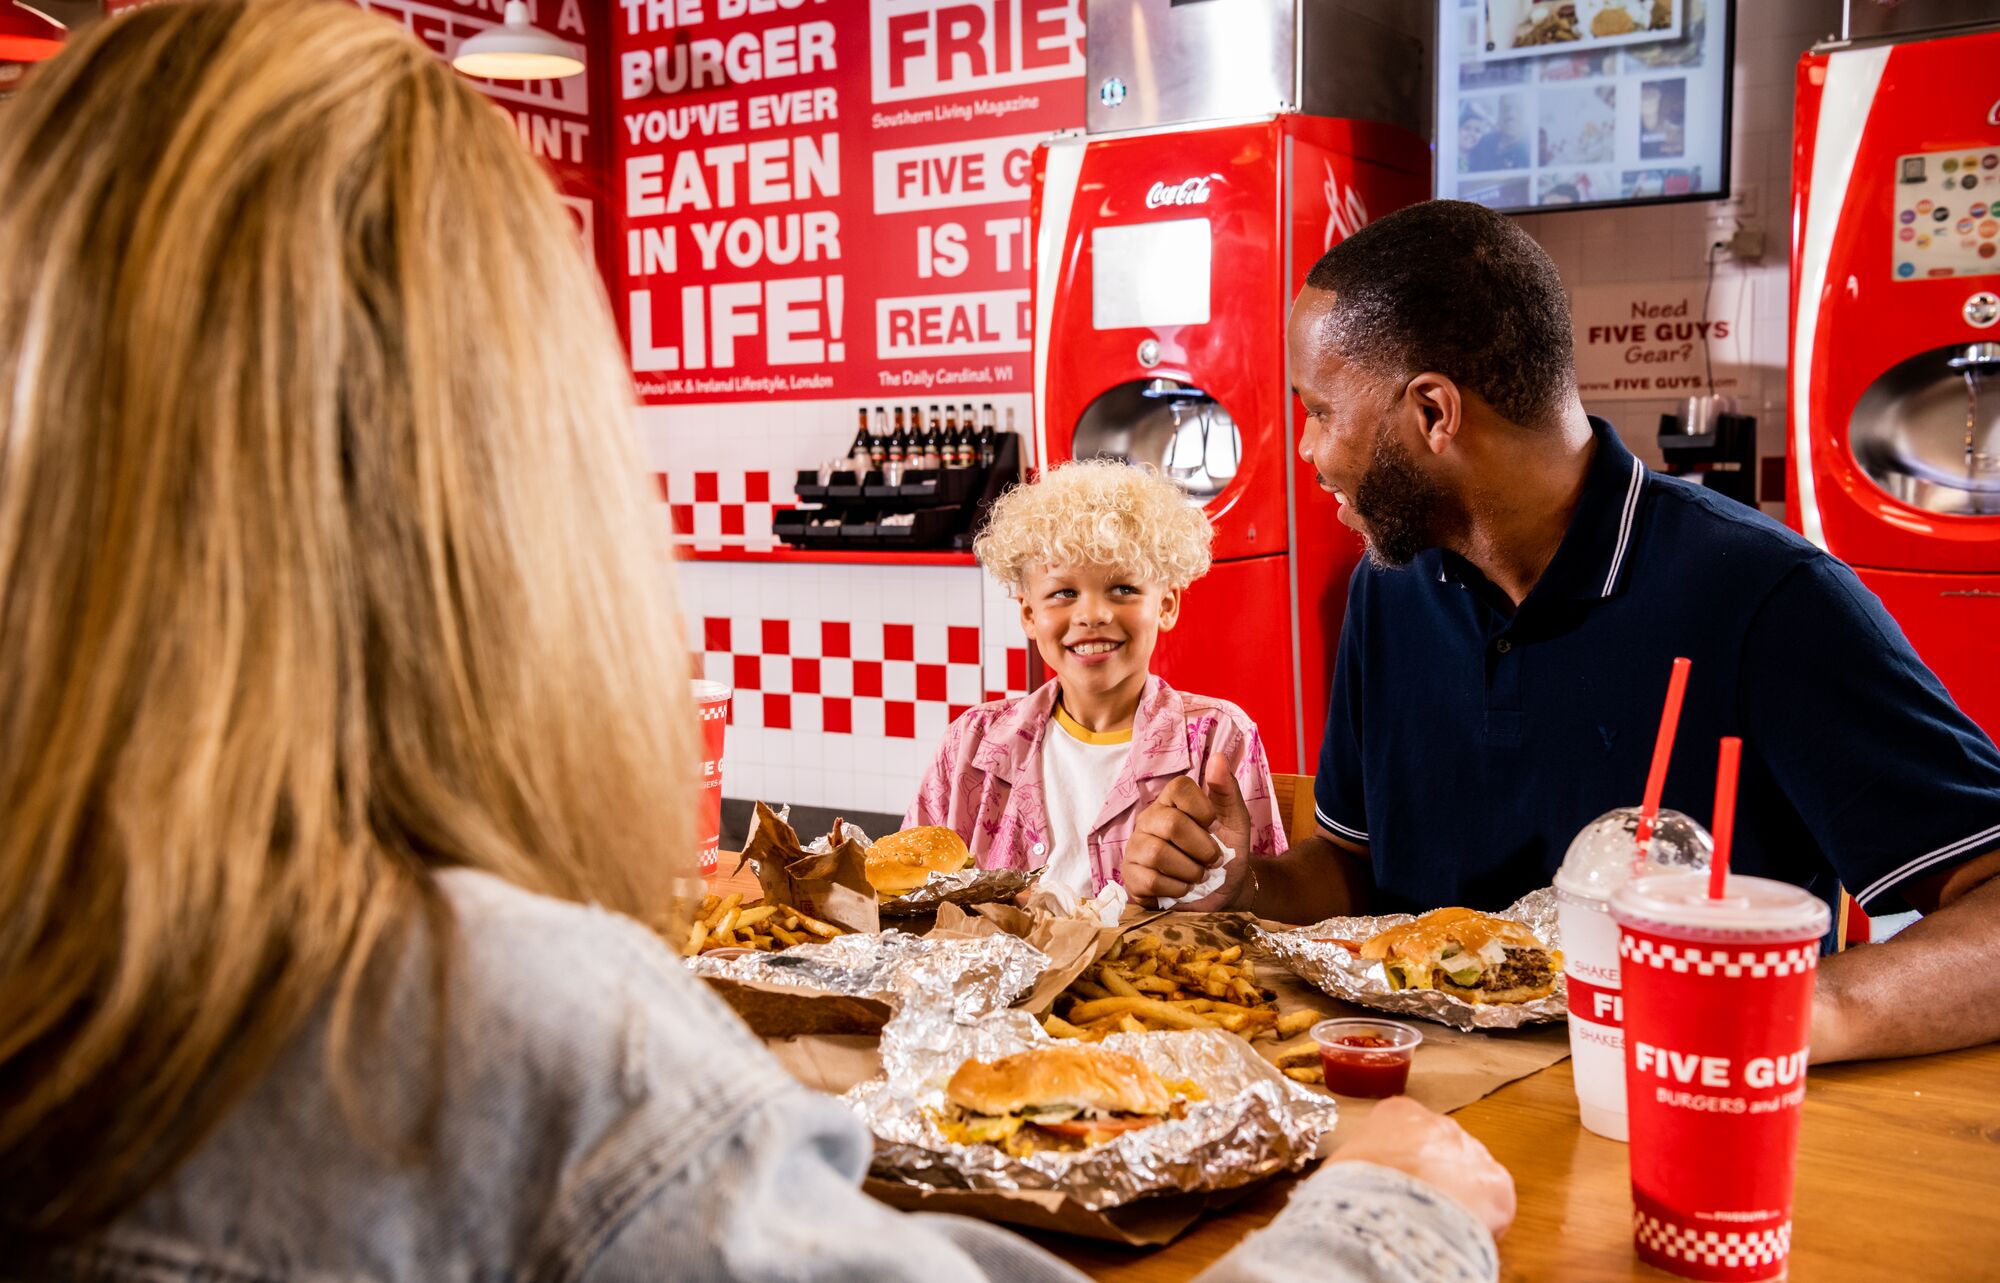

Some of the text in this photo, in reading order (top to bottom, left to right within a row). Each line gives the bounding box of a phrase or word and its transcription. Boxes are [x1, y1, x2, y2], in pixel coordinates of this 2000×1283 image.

[620, 0, 704, 35] THE
[621, 20, 838, 100] BURGER
[888, 0, 1086, 88] FRIE
[624, 87, 839, 145] YOU'VE EVER
[871, 96, 1040, 129] Southern Living Magazine
[626, 132, 841, 218] EATEN
[897, 153, 985, 199] FIVE
[627, 210, 842, 277] IN YOUR
[917, 216, 1031, 279] IS T
[629, 274, 846, 373] LIFE!
[888, 303, 1000, 348] REAL
[1631, 299, 1689, 319] Need
[1588, 320, 1729, 344] FIVE GUYS
[1624, 343, 1693, 364] Gear?
[667, 379, 684, 395] UK
[685, 378, 695, 394] &
[695, 377, 734, 394] Ireland
[790, 373, 834, 390] London
[878, 371, 900, 386] The
[902, 369, 934, 388] Daily
[1634, 1041, 1732, 1088] FIVE
[1655, 1086, 1747, 1115] BURGERS
[1748, 1095, 1781, 1115] and
